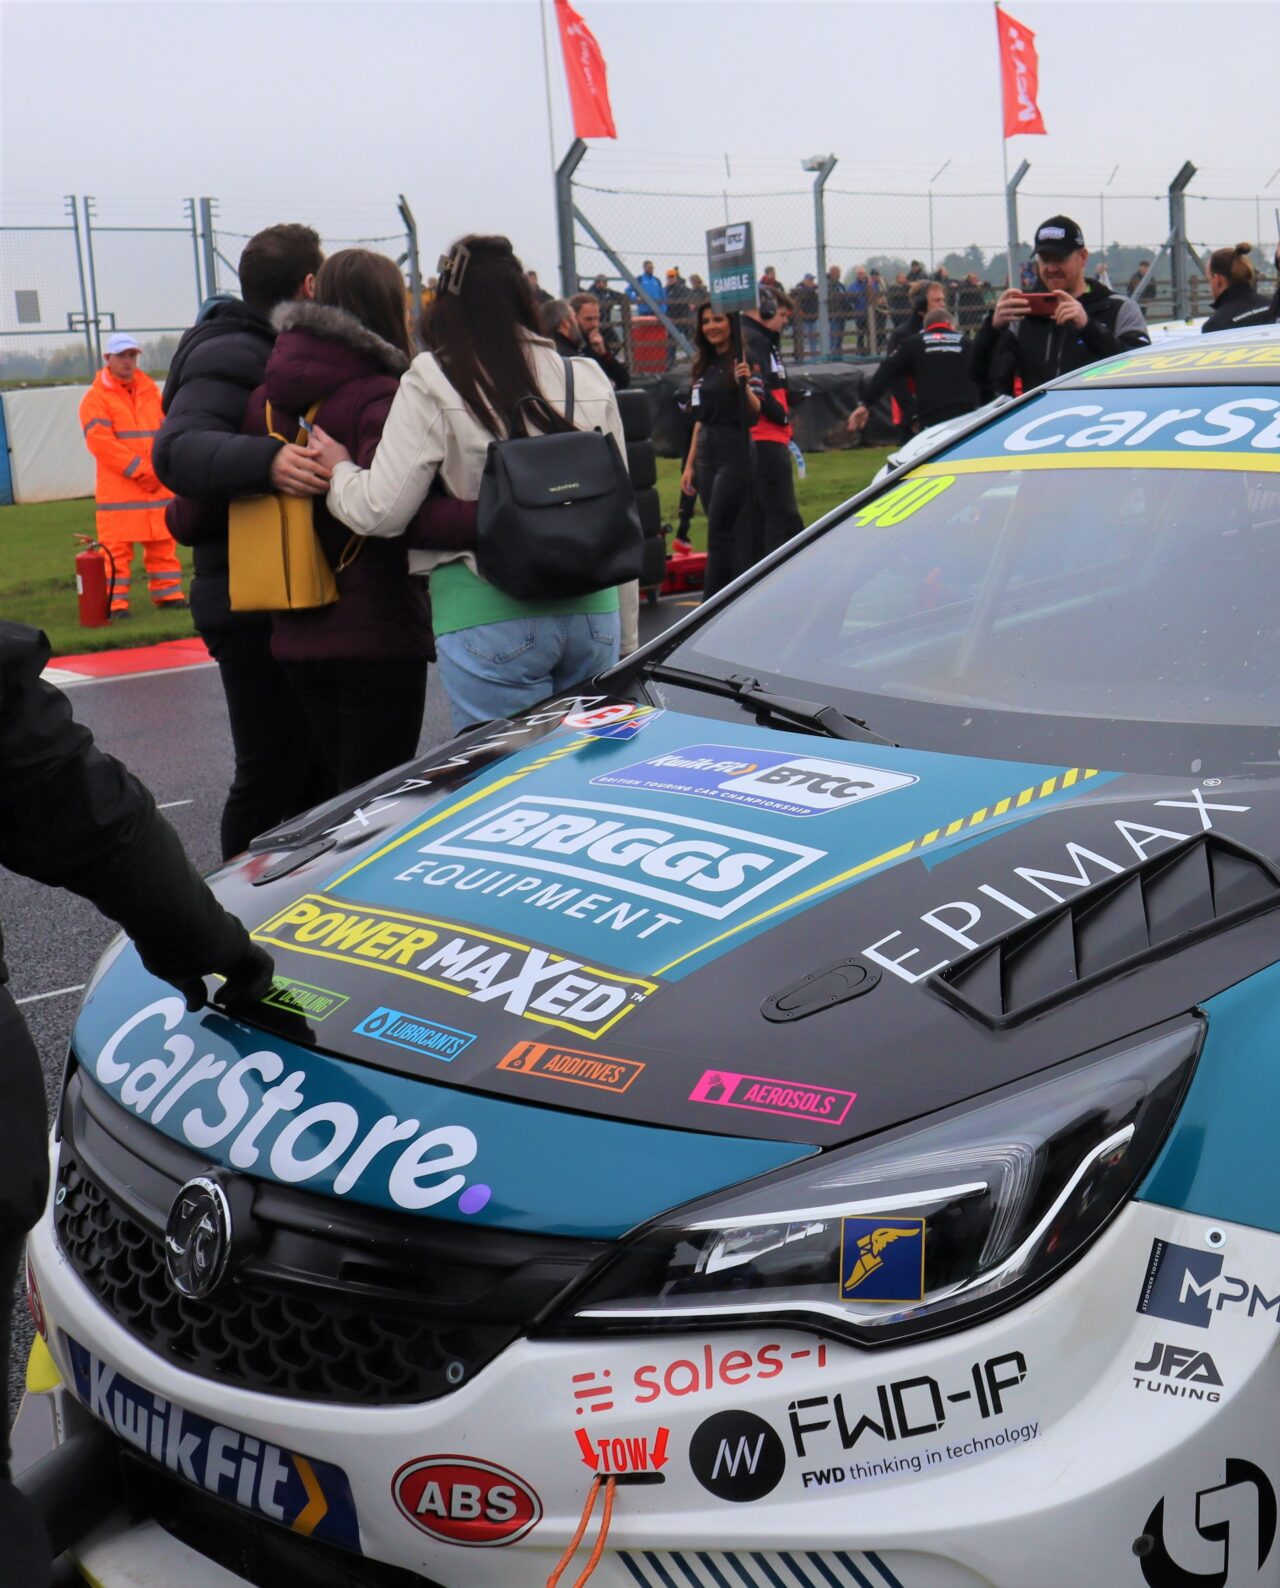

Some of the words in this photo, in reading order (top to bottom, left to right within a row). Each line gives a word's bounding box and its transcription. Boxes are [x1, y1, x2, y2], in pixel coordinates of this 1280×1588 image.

[713, 274, 749, 294] GAMBLE
[854, 475, 956, 528] 40
[599, 777, 642, 786] BRITISH
[643, 780, 692, 794] TOURING
[692, 787, 718, 797] CAR
[719, 791, 813, 815] CHAMPIONSHIP
[754, 767, 876, 799] BTCC
[463, 809, 774, 892] BRIGGS
[395, 861, 683, 940] EQUIPMENT
[861, 788, 1252, 984] EPIMAX
[264, 902, 438, 961] POWER
[416, 938, 628, 1024] MAXED
[387, 1020, 465, 1054] LUBRICANTS
[545, 1052, 626, 1085] ADDITIVES
[742, 1081, 838, 1115] AEROSOLS
[1142, 1274, 1154, 1312] STRONGER
[1151, 1242, 1163, 1275] TOGETHER
[634, 1337, 828, 1404] sales-i
[1134, 1341, 1225, 1387] JFA
[787, 1351, 1028, 1458] FWD-IP
[1132, 1377, 1221, 1403] TUNING
[597, 1436, 648, 1473] TOW
[801, 1466, 846, 1488] FWD
[850, 1455, 922, 1481] thinking
[926, 1449, 943, 1465] in
[945, 1421, 1040, 1460] technology
[416, 1481, 518, 1520] ABS
